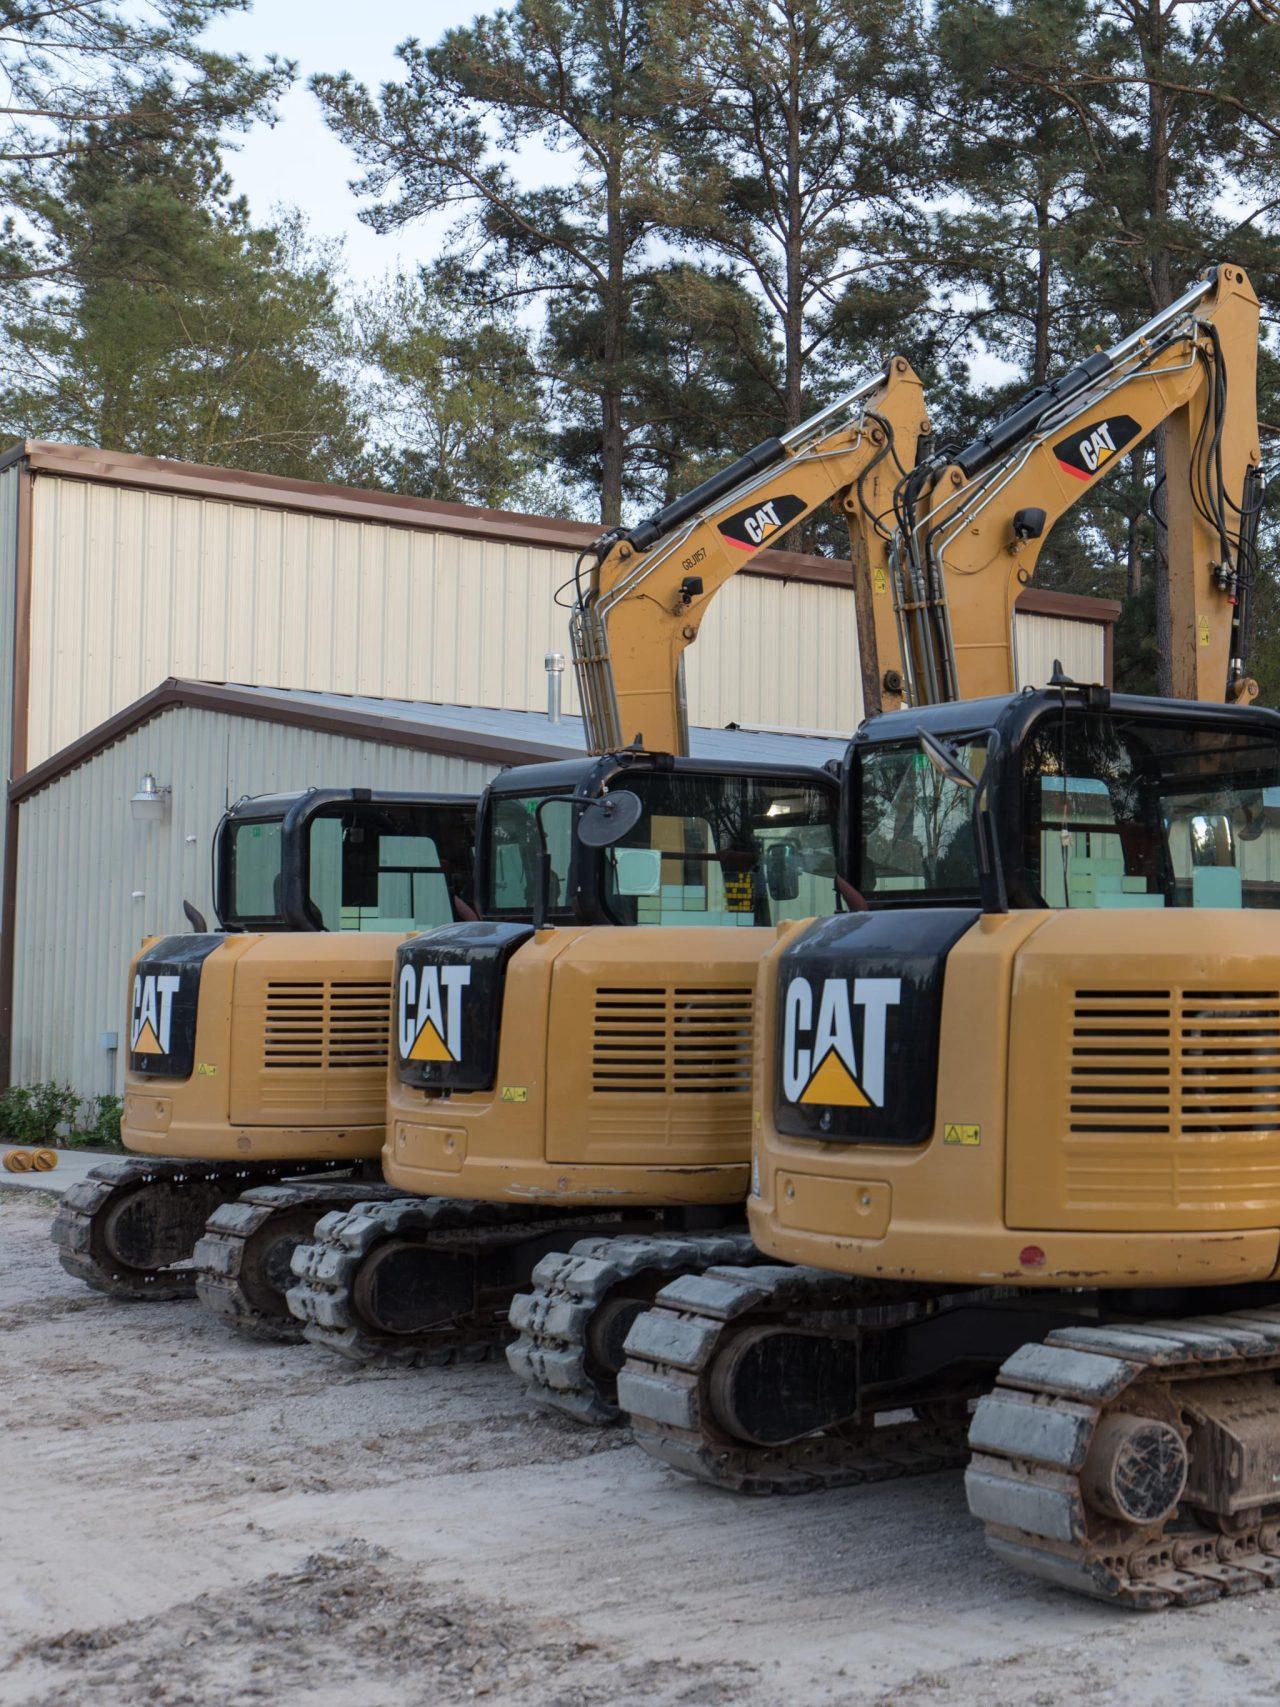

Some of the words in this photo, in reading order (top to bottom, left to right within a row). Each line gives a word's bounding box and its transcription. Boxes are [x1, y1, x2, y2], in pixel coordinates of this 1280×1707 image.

[1080, 422, 1117, 470] CAT
[744, 501, 781, 542] CAT
[130, 974, 180, 1054] CAT
[399, 963, 471, 1062] CAT
[783, 976, 901, 1107] CAT
